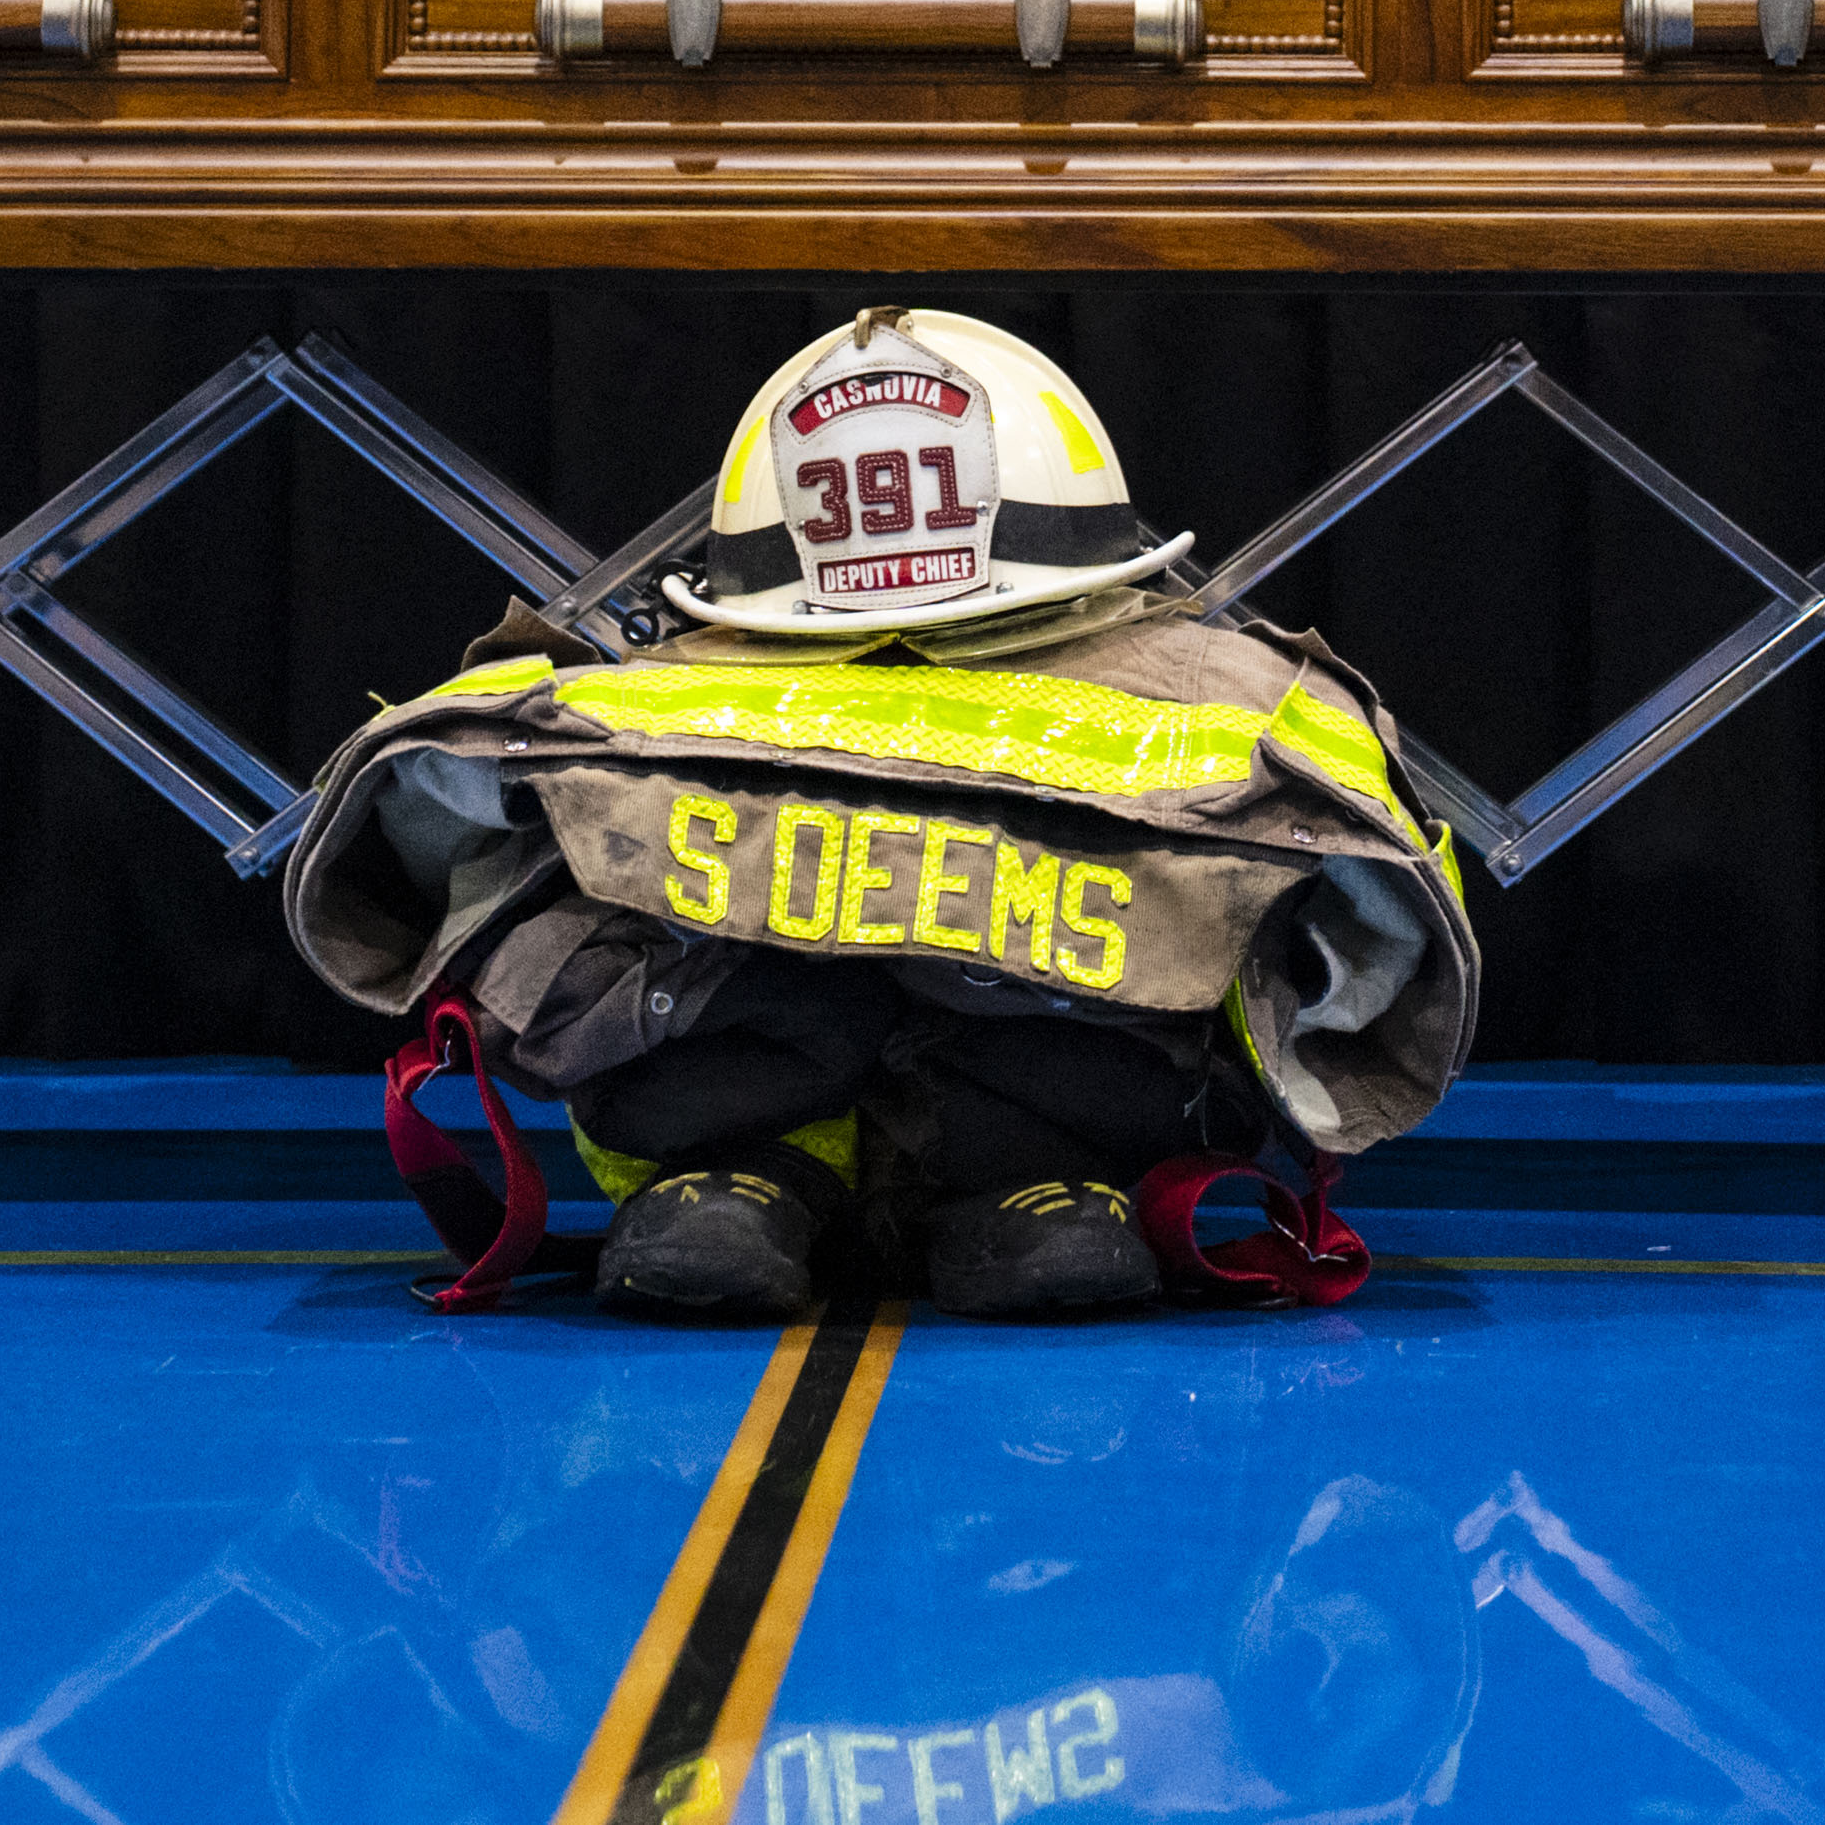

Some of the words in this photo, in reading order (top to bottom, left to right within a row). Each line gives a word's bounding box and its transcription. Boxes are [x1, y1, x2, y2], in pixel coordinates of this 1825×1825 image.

[796, 446, 977, 544] 391
[824, 559, 901, 593] DEPUTY
[911, 552, 973, 583] CHIEF
[664, 793, 738, 925] S
